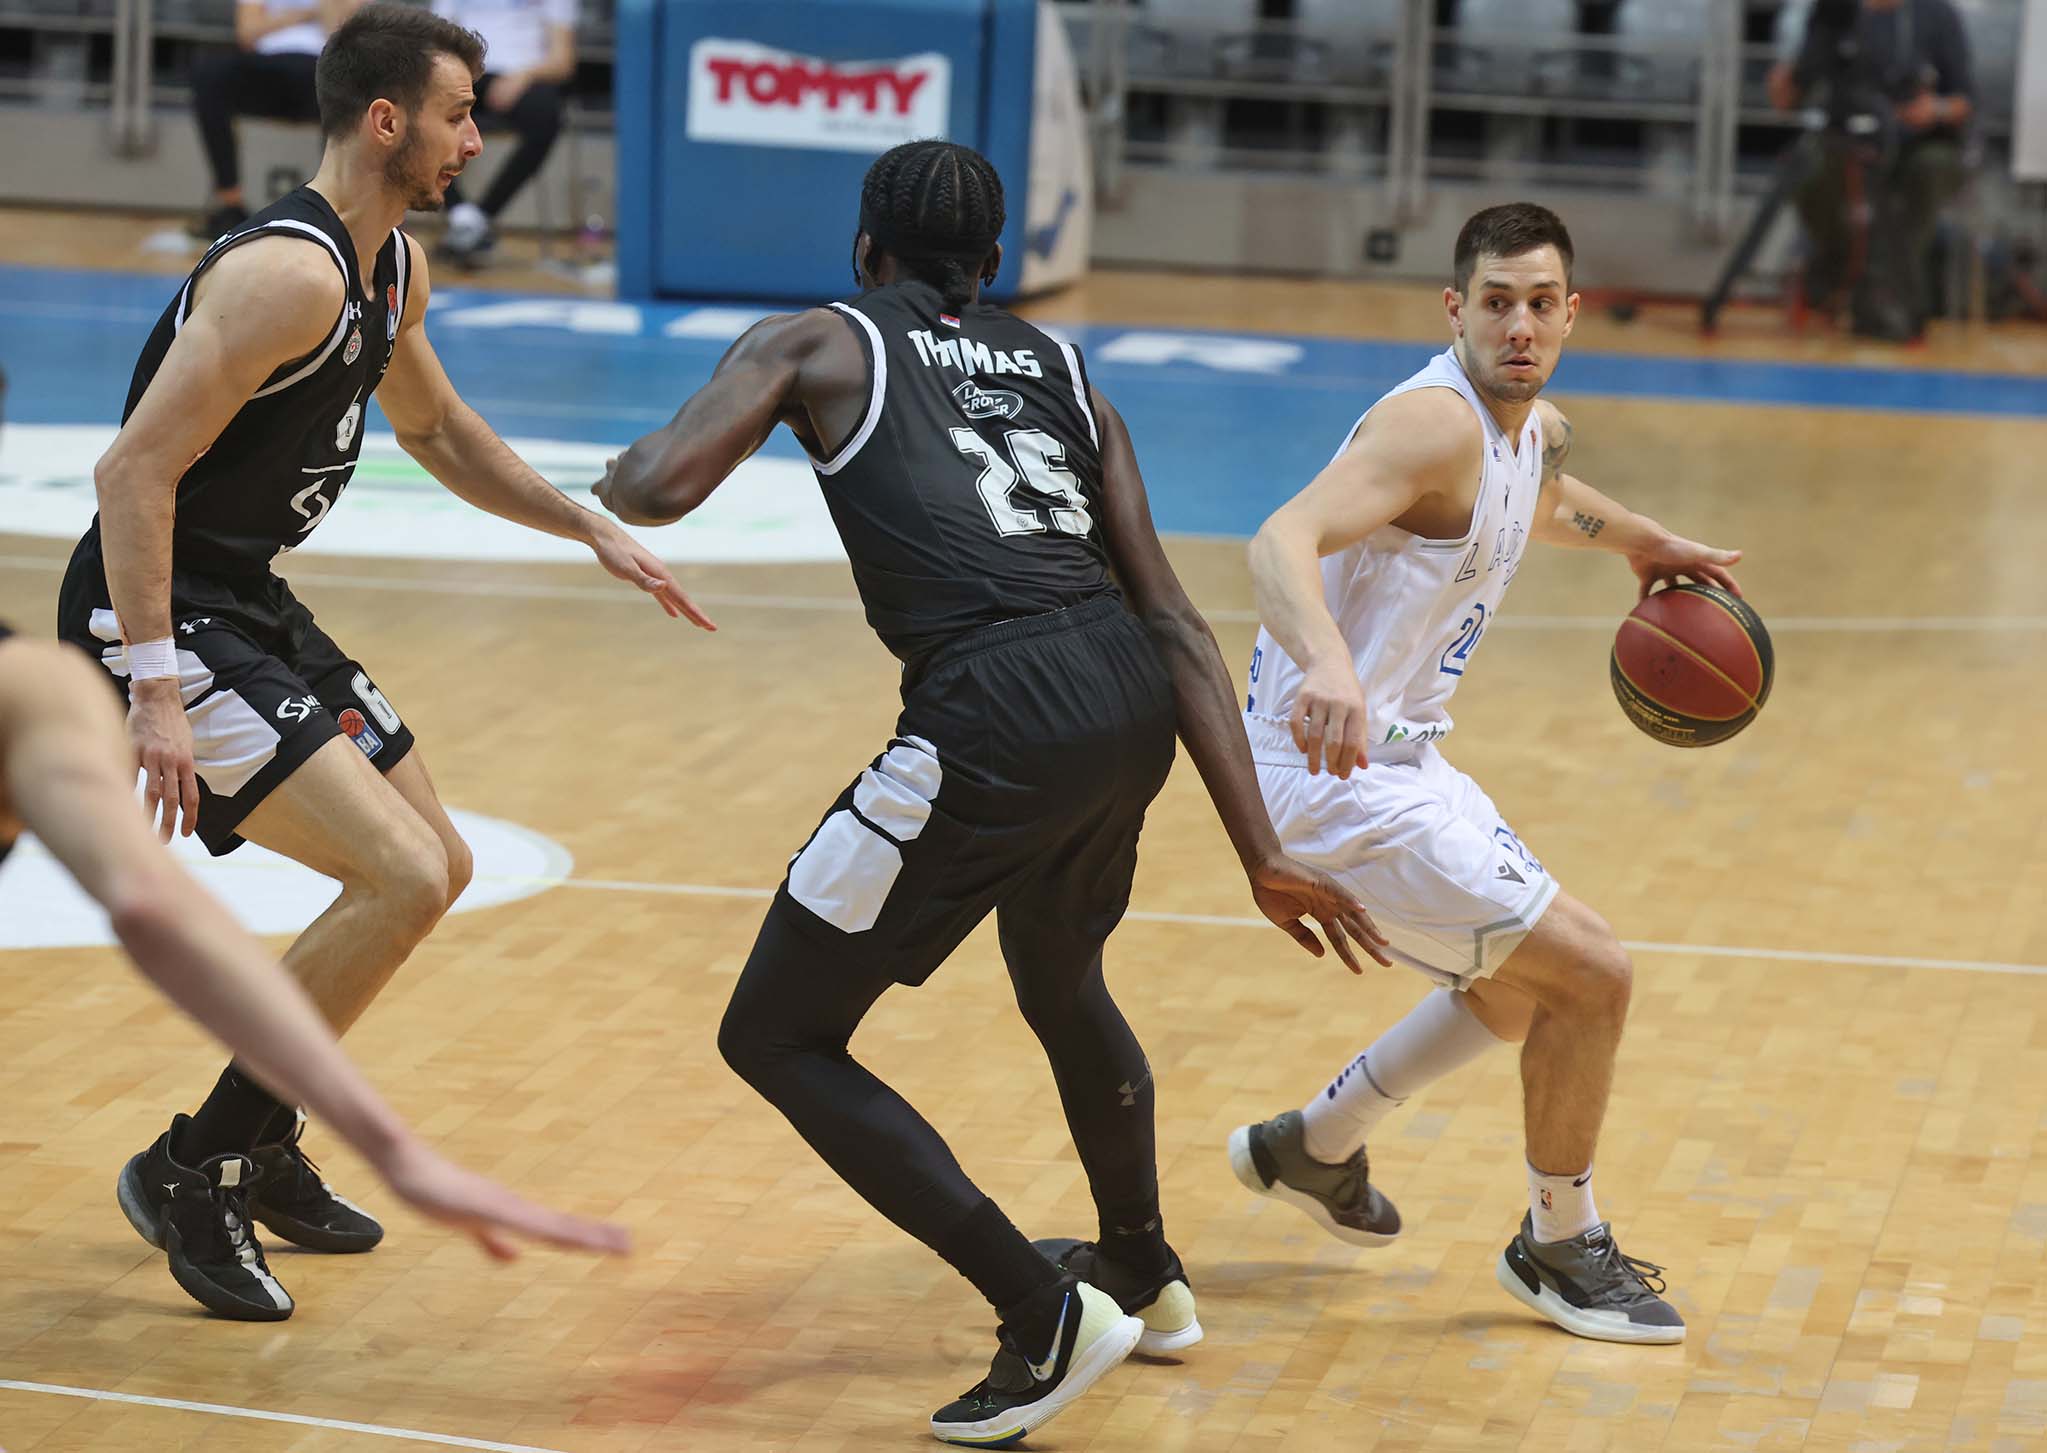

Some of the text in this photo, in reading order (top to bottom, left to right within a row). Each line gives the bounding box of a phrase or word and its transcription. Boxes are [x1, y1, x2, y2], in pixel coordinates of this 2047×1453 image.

[707, 57, 929, 115] TOMMY
[949, 427, 1094, 539] 25
[351, 670, 402, 735] 6
